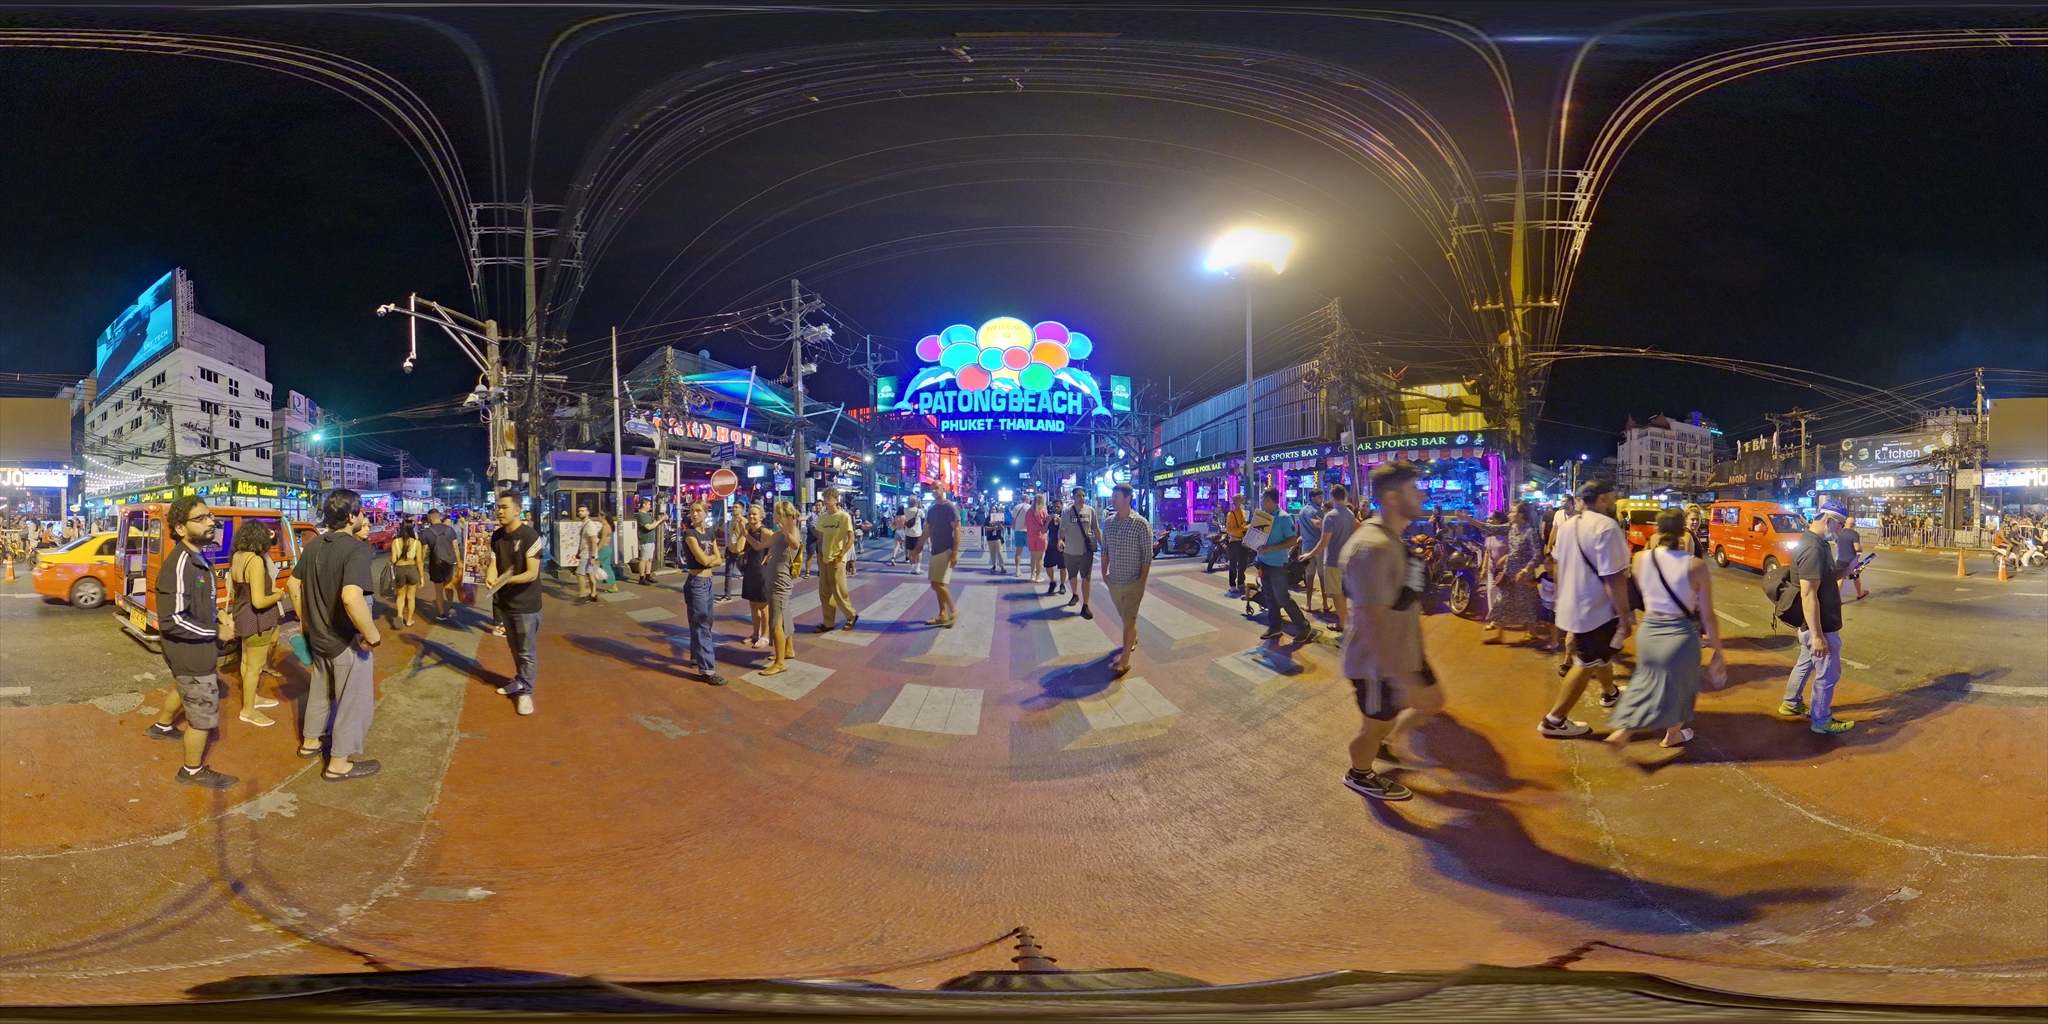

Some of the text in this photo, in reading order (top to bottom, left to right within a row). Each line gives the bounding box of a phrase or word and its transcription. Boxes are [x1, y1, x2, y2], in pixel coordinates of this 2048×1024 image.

[919, 389, 1083, 415] PATONG BEACH
[668, 417, 713, 440] RED
[716, 425, 753, 447] HOT
[941, 418, 1065, 432] PHUKET THAILAND
[1338, 436, 1448, 453] OSAR SPORTS BAR
[1270, 451, 1300, 461] SPORTS
[1301, 448, 1319, 457] BAR
[237, 481, 258, 495] Atlas
[1848, 474, 1895, 490] kitchen
